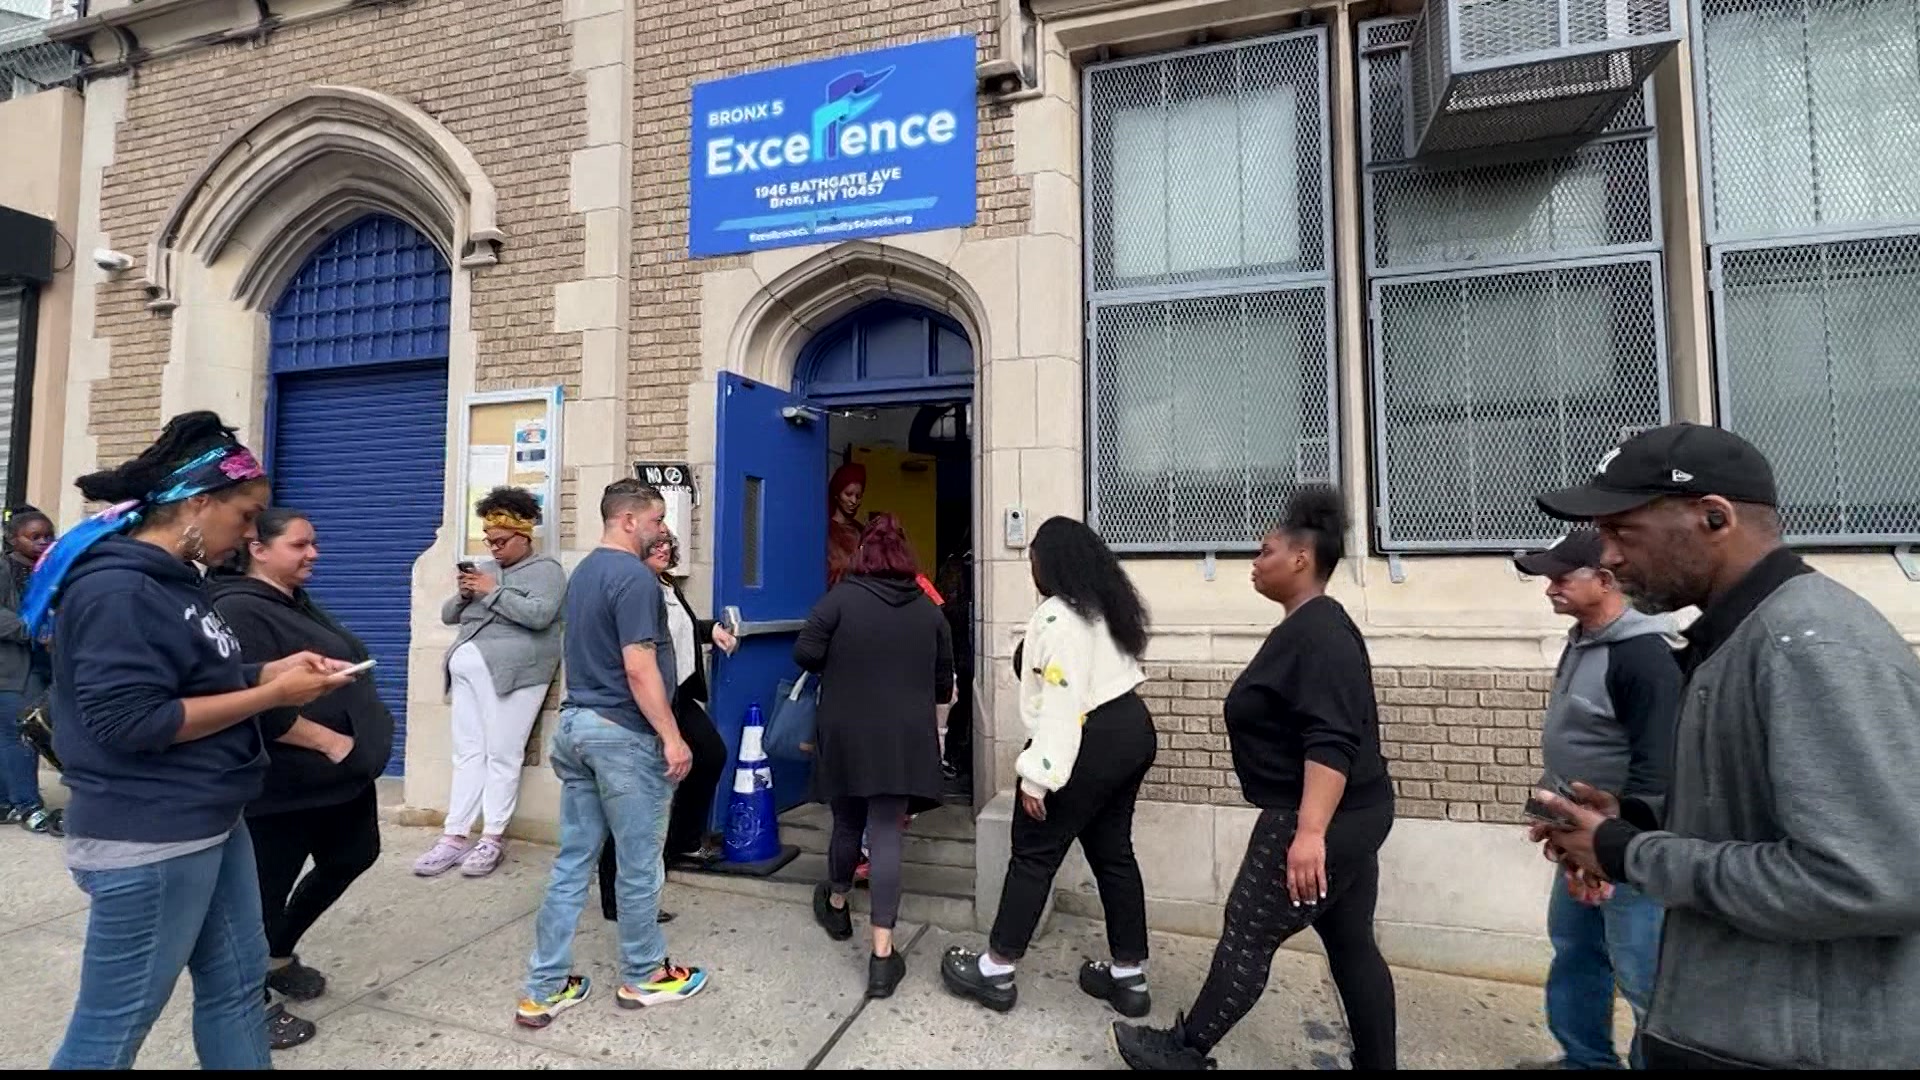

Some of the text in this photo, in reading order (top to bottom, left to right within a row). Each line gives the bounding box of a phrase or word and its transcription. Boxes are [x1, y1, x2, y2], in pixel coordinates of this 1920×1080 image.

[709, 101, 783, 127] BRONX 5
[755, 168, 901, 199] 1946 BATHGATE AVE
[770, 183, 885, 209] Bronx, NY 10457
[646, 467, 662, 483] NO
